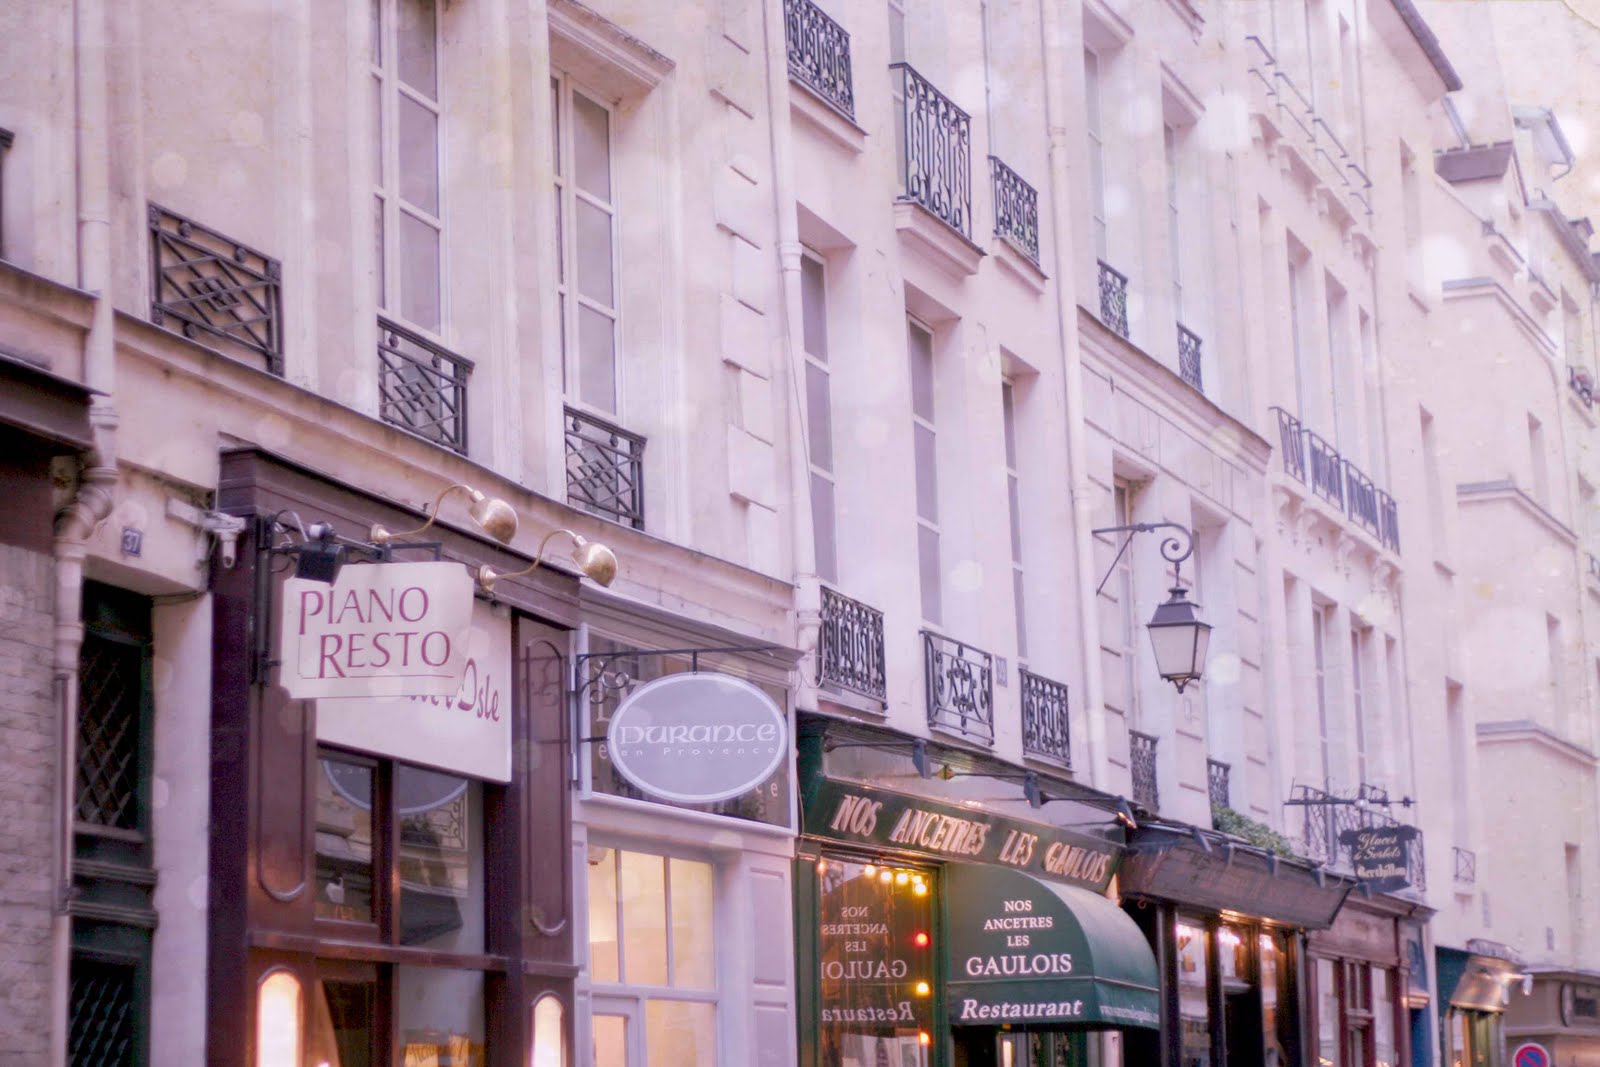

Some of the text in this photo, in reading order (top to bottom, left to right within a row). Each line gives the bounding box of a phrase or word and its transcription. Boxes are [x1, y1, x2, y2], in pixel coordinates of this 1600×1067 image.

[124, 530, 140, 554] 37
[299, 586, 429, 635] PIANO
[318, 631, 451, 679] RESTO
[621, 746, 777, 757] en Provence
[830, 794, 1112, 883] NOS ANCETRES LES GAULOIS
[1004, 899, 1032, 912] NOS
[983, 916, 1053, 931] ANCETRES
[1007, 934, 1030, 947] LES
[966, 953, 1072, 976] GAULOIS
[961, 998, 1083, 1020] Restaurant
